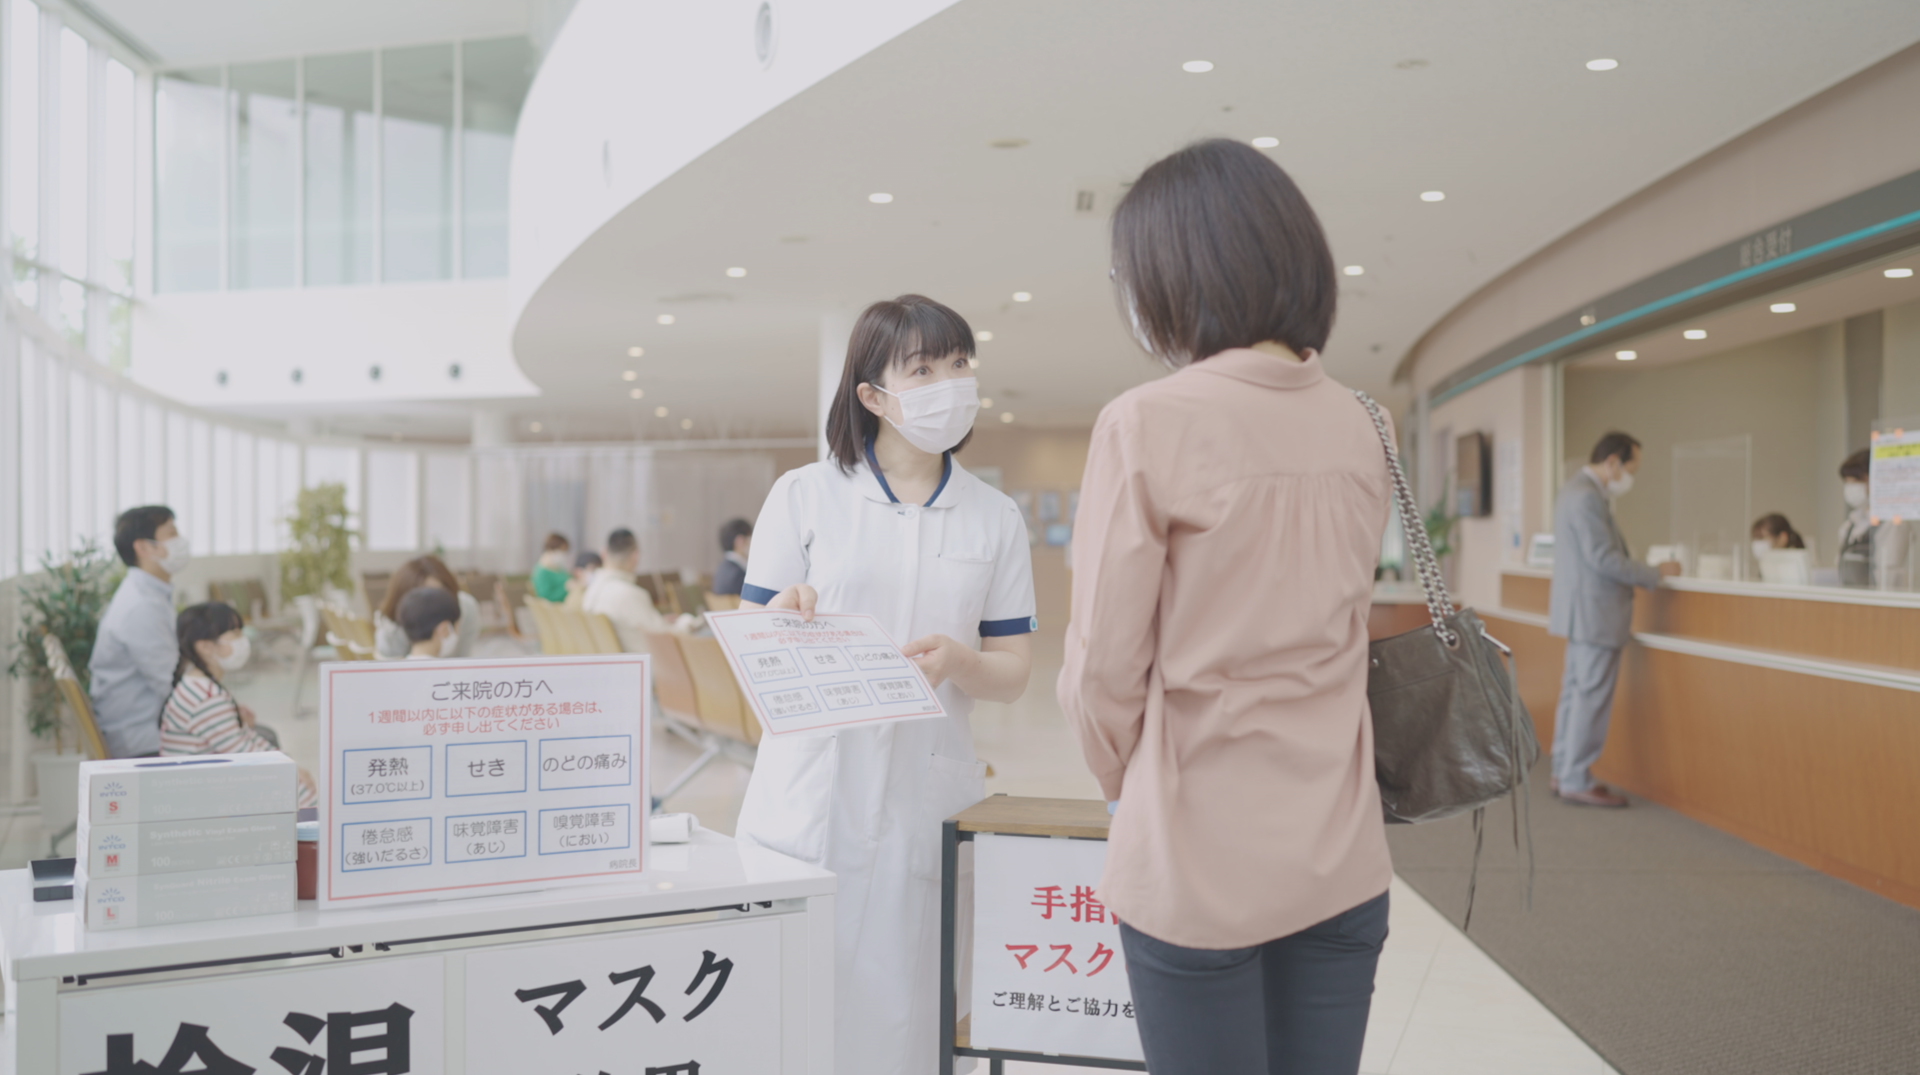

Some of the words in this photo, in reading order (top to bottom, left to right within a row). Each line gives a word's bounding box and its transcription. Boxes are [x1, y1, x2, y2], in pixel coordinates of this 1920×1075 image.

[757, 656, 783, 668] 発熱
[814, 654, 837, 665] せき
[854, 653, 900, 662] のどの痛み
[431, 679, 553, 702] ご来院の方へ
[368, 701, 604, 724] 1週間以内に以下の症状がある場合は、
[422, 716, 560, 736] 必ず申し出てください
[367, 756, 409, 778] 発熱
[467, 758, 506, 778] せき
[542, 753, 628, 773] のどの痛み
[108, 801, 119, 812] S
[453, 818, 519, 838] 味覚障害
[553, 812, 616, 831] 嗅覚障害
[149, 828, 202, 841] Synthetic
[205, 828, 226, 837] Vinyl
[250, 824, 277, 832] Gloves
[361, 826, 414, 846] 倦怠感
[559, 832, 610, 849] （におい）
[345, 846, 429, 867] （強いだるさ）
[466, 840, 506, 857] （あじ）
[106, 854, 118, 864] M
[150, 856, 171, 867] 100
[608, 858, 638, 870] 病院長
[197, 875, 231, 886] Nitrile
[106, 907, 116, 917] L
[1031, 885, 1120, 925] 手指
[1005, 942, 1128, 977] マスク
[514, 949, 734, 1036] マスク
[992, 991, 1135, 1018] ご理解とご協力を
